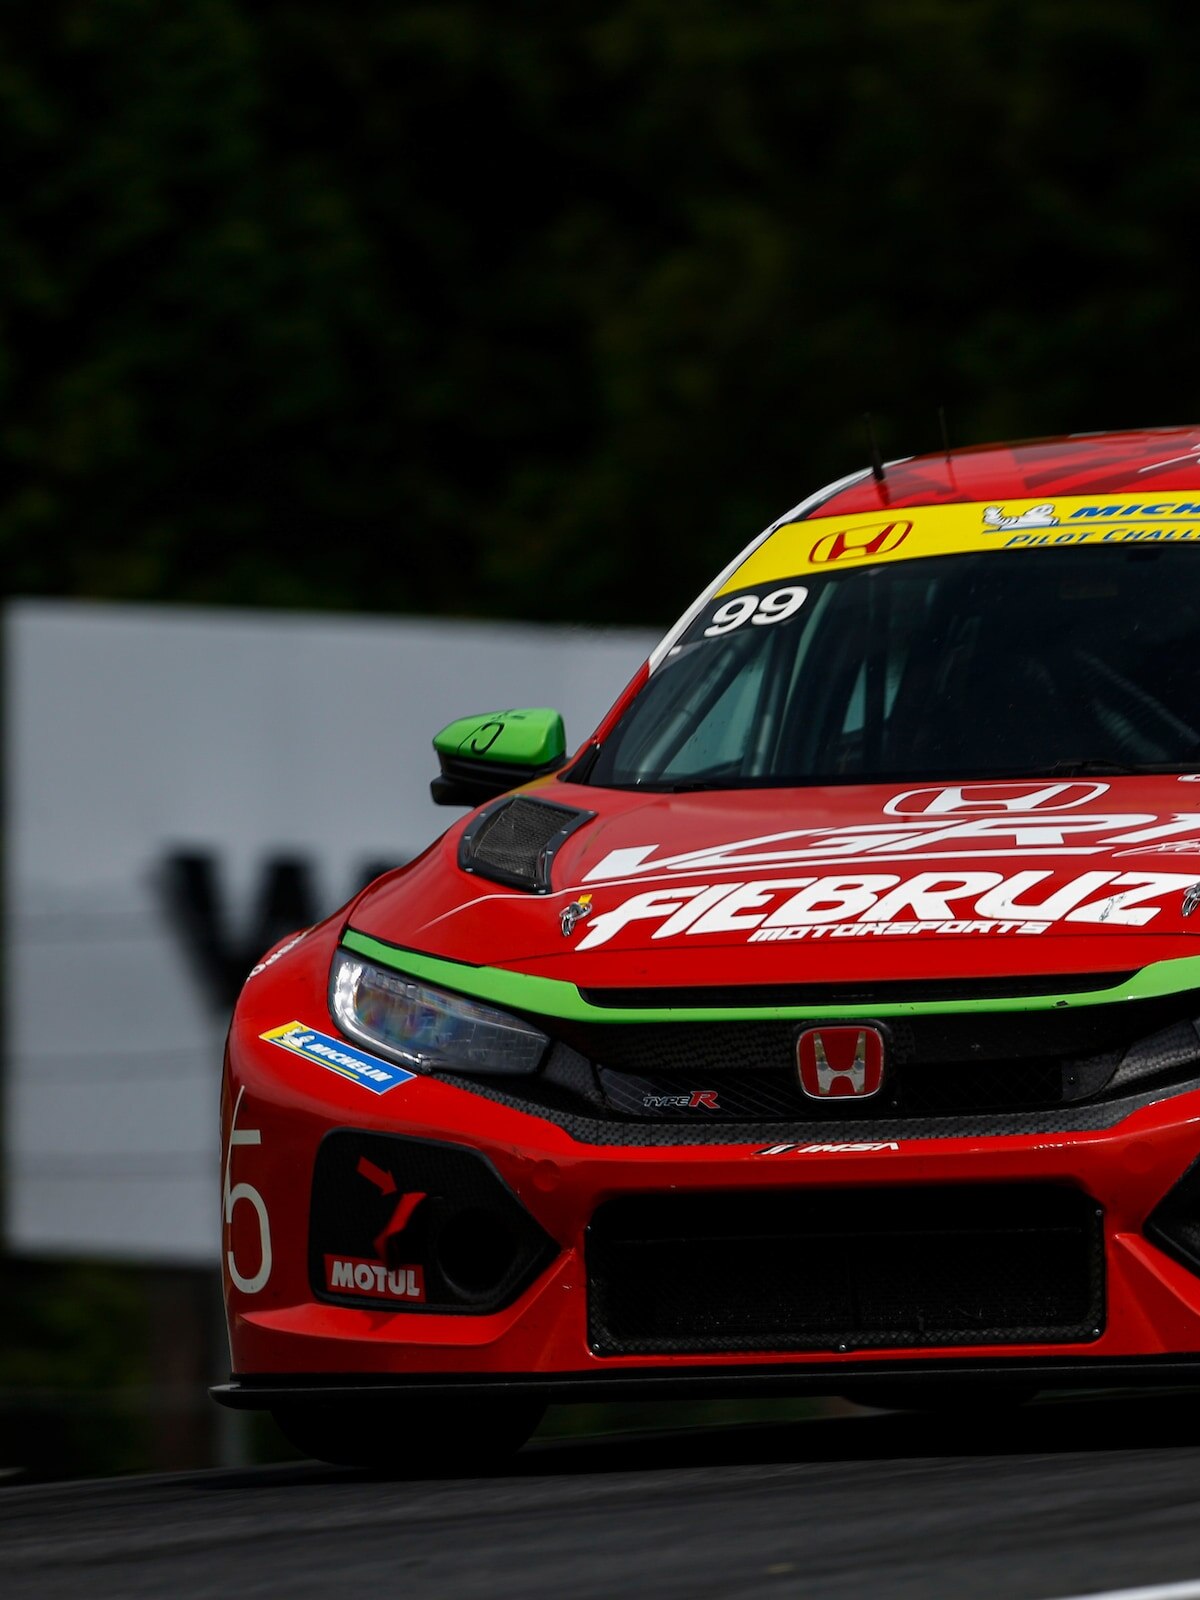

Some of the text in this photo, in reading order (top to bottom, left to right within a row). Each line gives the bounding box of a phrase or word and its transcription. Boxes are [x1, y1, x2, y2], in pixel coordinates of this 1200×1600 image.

[1004, 531, 1096, 548] PILOT
[703, 585, 809, 638] 99
[746, 920, 1054, 943] MOTORSPORTS
[306, 1040, 394, 1085] MICHELIN
[797, 1142, 900, 1154] IMSA
[331, 1260, 421, 1297] MOTUL
